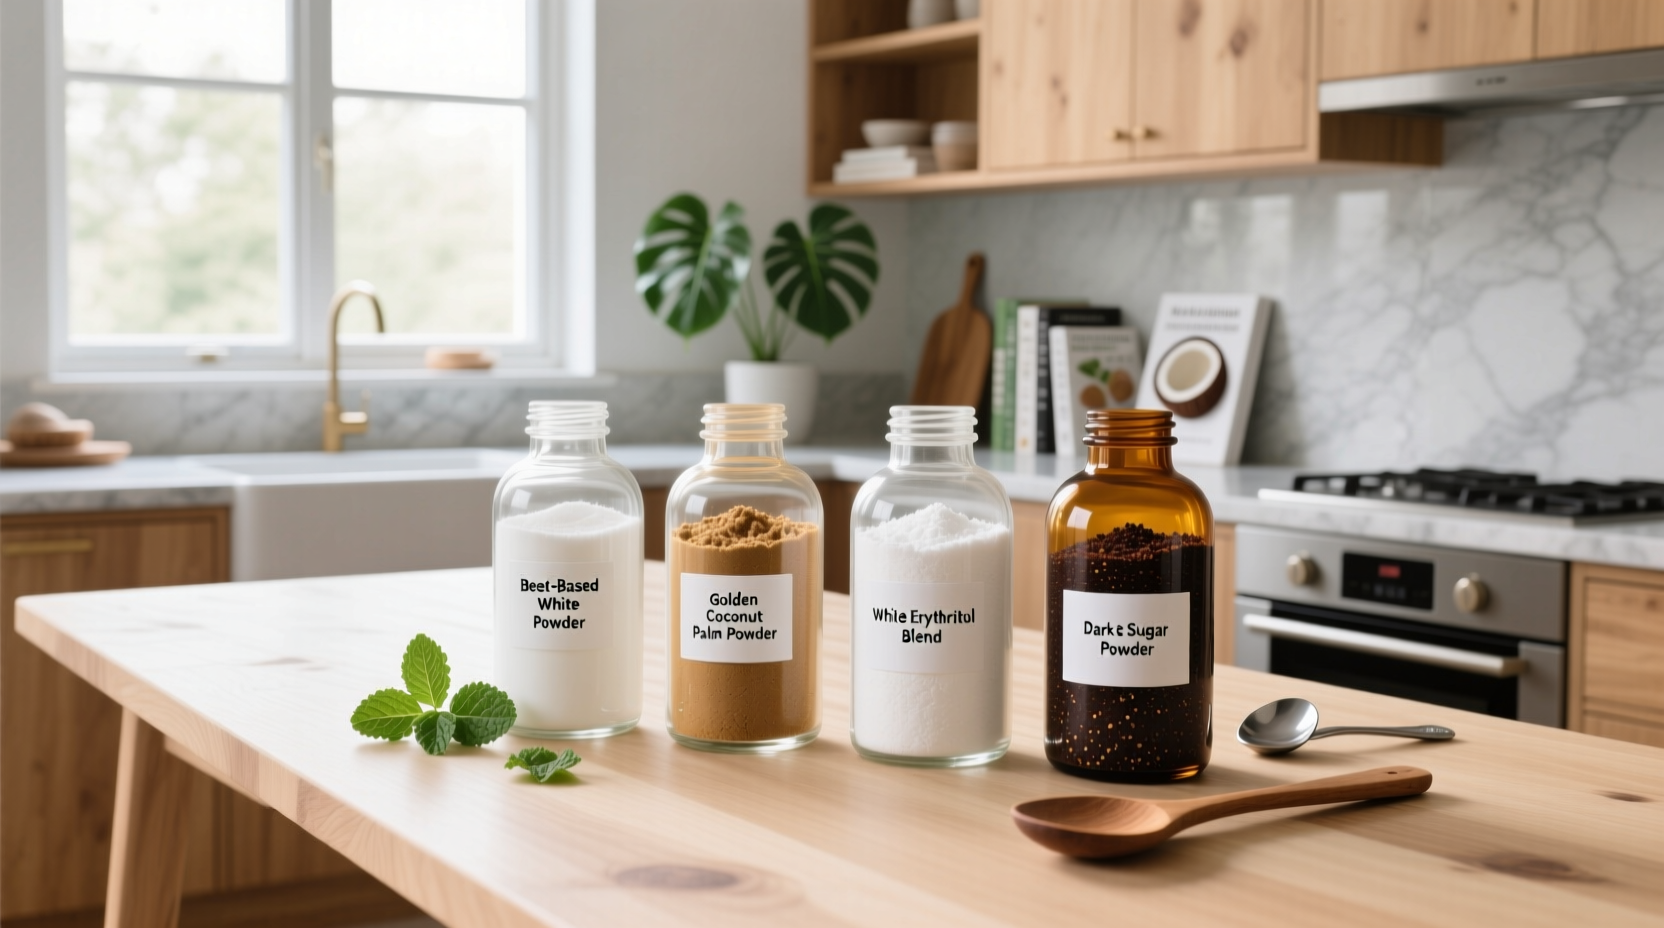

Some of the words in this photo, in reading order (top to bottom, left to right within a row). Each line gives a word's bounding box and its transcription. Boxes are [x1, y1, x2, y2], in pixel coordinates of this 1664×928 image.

[520, 577, 599, 594] Beet-Based
[537, 596, 580, 611] White
[709, 590, 758, 607] Golden
[533, 614, 586, 629] Powder
[706, 609, 764, 623] Coconut
[910, 607, 976, 629] Erythritol
[693, 625, 722, 640] Palm
[726, 626, 778, 641] Powder
[902, 627, 942, 644] Blend
[1127, 622, 1169, 641] Sugar
[1100, 640, 1155, 656] Powder
